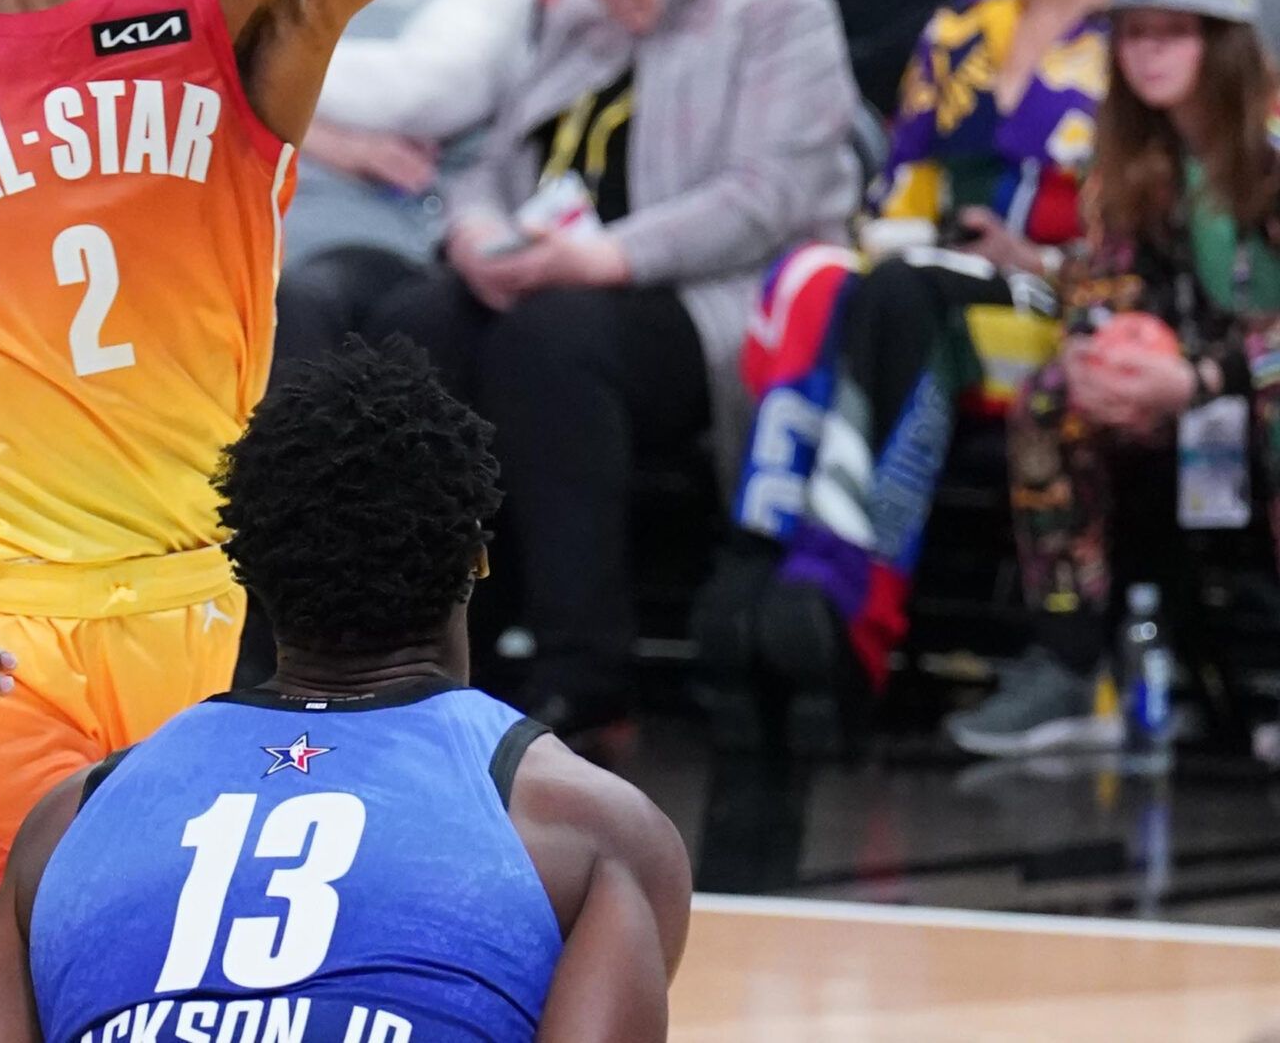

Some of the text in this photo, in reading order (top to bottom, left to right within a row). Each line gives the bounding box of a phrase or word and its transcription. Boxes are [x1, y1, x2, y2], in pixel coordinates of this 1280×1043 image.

[100, 15, 183, 49] KIA
[51, 222, 137, 377] 2
[153, 791, 367, 994] 13
